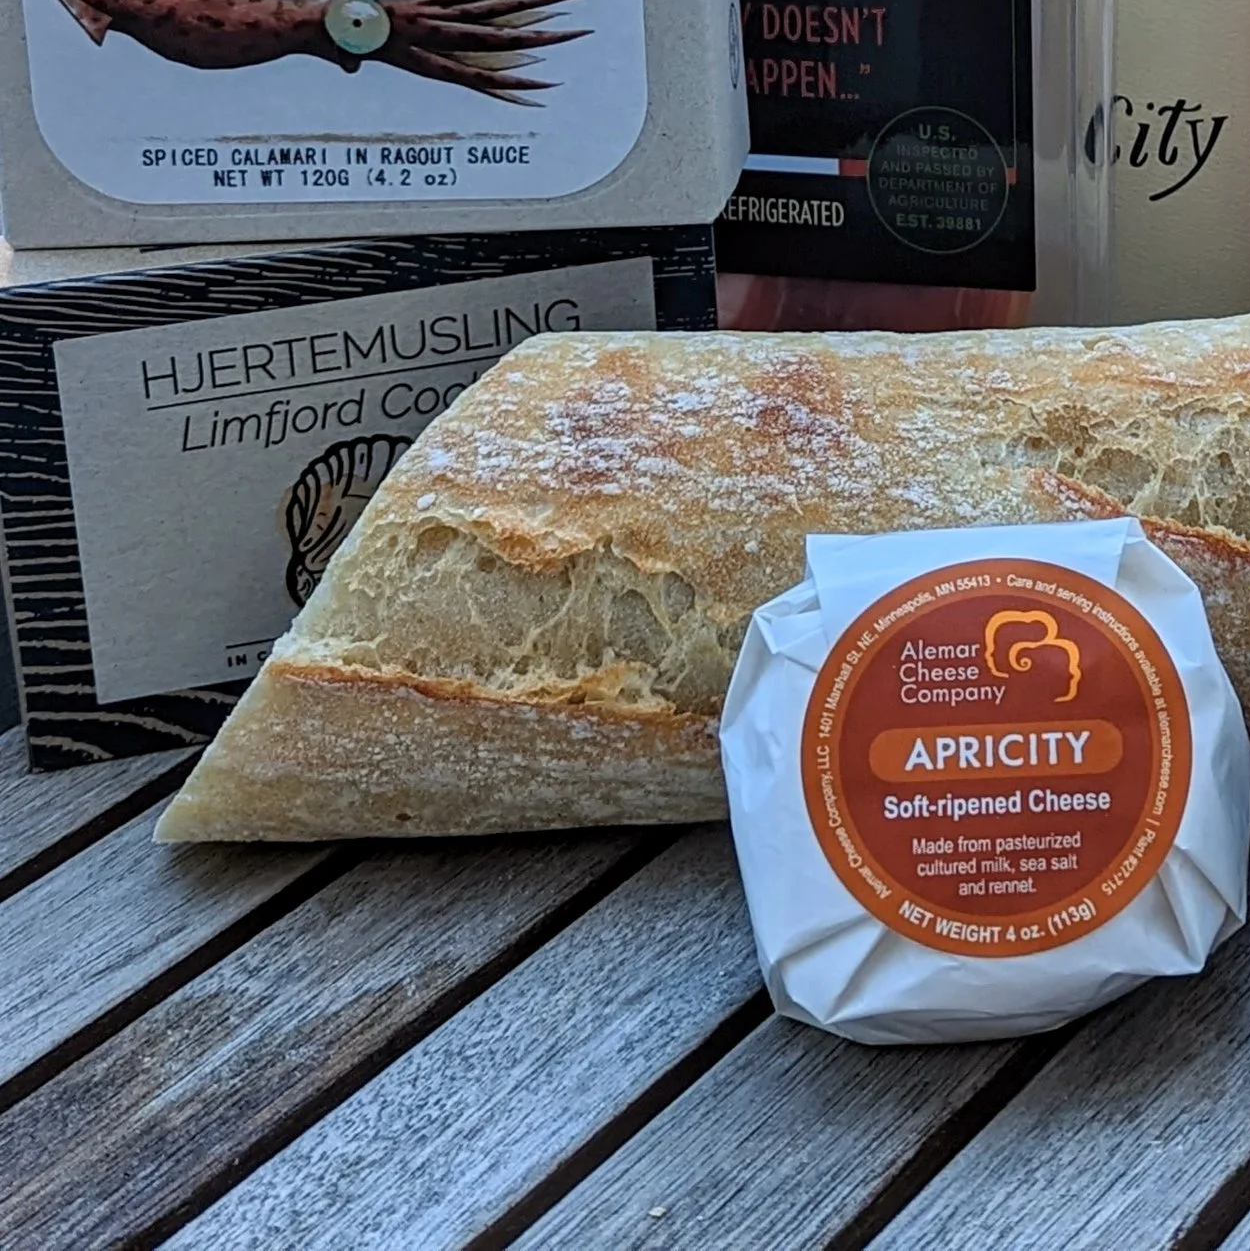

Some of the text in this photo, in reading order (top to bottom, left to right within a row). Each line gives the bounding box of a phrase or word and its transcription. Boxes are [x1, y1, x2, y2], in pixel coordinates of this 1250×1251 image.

[142, 145, 531, 166] SPICED CALAMARI IN RAGOUT SAUCE
[1083, 94, 1229, 202] City
[214, 166, 458, 187] NET WT 120G (4.2 oz)
[896, 213, 933, 229] EST.
[141, 297, 582, 400] HJERTEMUSLING
[181, 395, 362, 453] Limfjord
[935, 581, 955, 598] MN
[956, 574, 991, 591] 55413
[1006, 573, 1033, 589] Care
[1034, 581, 1057, 595] and
[872, 590, 937, 633] Minneapolis,
[1056, 586, 1093, 613] serving
[1091, 603, 1139, 654] instructions
[900, 639, 981, 661] Alemar
[899, 661, 980, 683] Cheese
[1133, 649, 1162, 696] available
[824, 662, 853, 710] Marshall
[900, 684, 1007, 707] Company
[1153, 696, 1167, 709] at
[818, 712, 836, 739] 1401
[817, 744, 830, 769] LLC
[903, 730, 1091, 772] APRICITY
[883, 788, 1112, 822] Soft-ripened Cheese
[912, 831, 1082, 857] Made from pasteurized
[916, 853, 1079, 878] cultured milk, sea salt
[958, 876, 1037, 896] and rennet.
[898, 897, 1098, 944] NET WEIGHT 4 oz. (113g)
